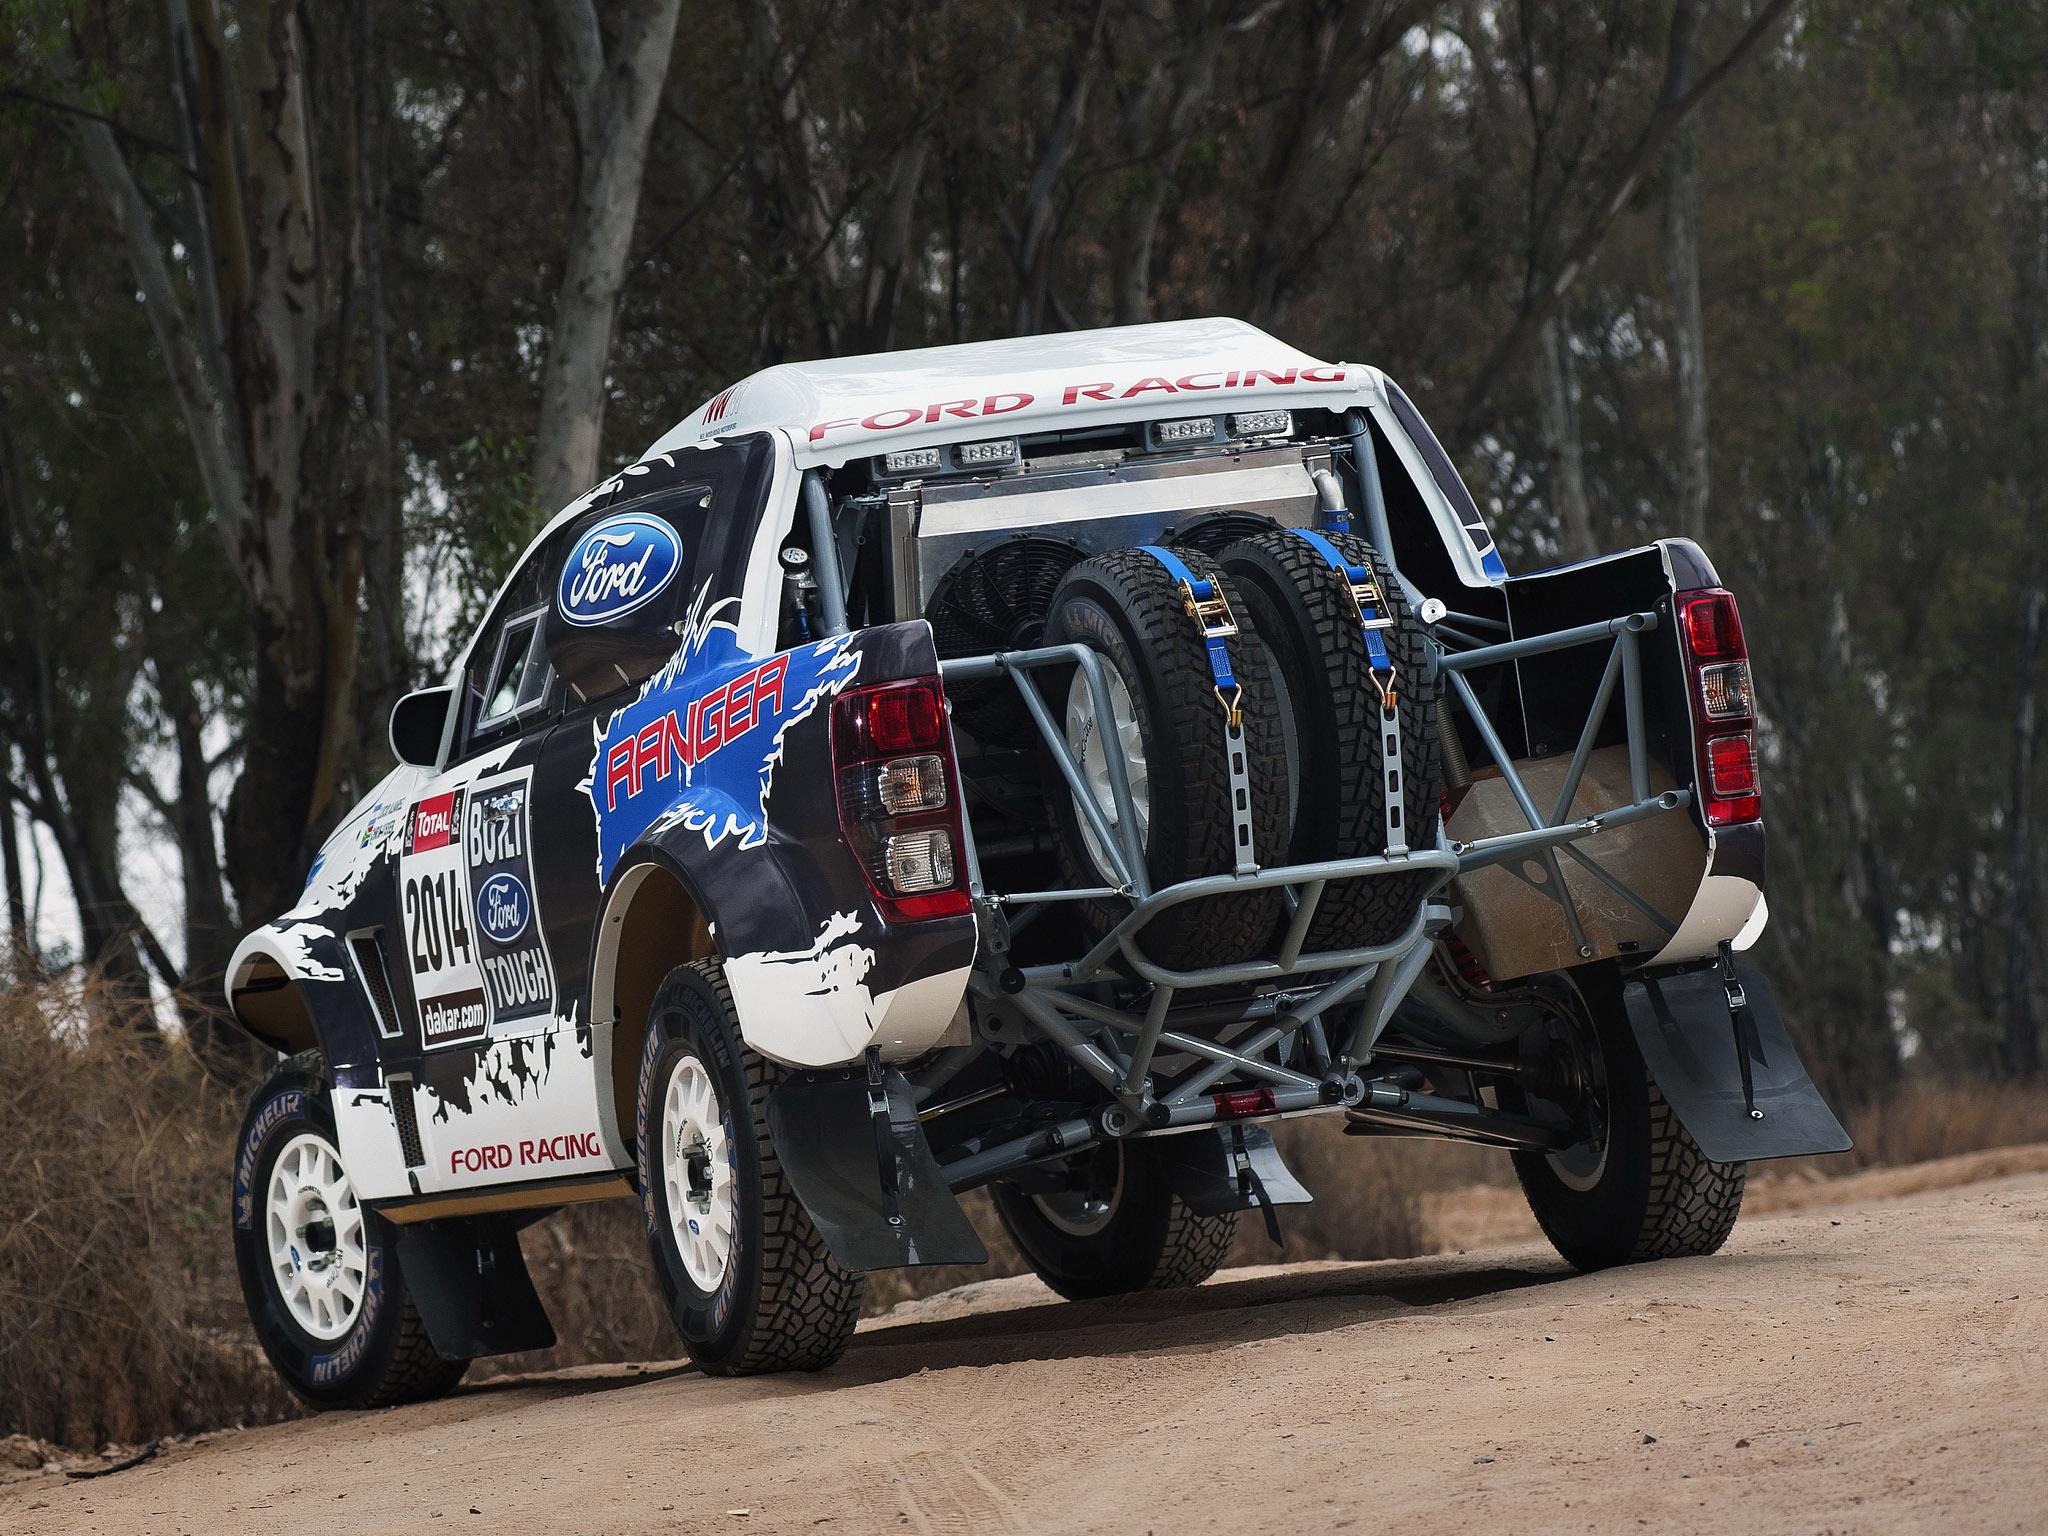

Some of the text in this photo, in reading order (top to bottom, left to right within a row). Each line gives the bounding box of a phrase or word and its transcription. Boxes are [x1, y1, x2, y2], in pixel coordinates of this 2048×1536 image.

[809, 367, 1347, 442] FORD RACING
[570, 530, 655, 608] Ford
[605, 654, 791, 812] RANGER
[418, 811, 450, 838] TOTAL
[405, 868, 471, 976] 2014
[488, 882, 518, 931] Ford
[486, 947, 550, 1010] TOUGH
[425, 1000, 485, 1037] dakar.com
[637, 1023, 659, 1187] MICHELIN
[451, 1132, 602, 1175] FORD RACING
[313, 1286, 377, 1382] MICHELIN
